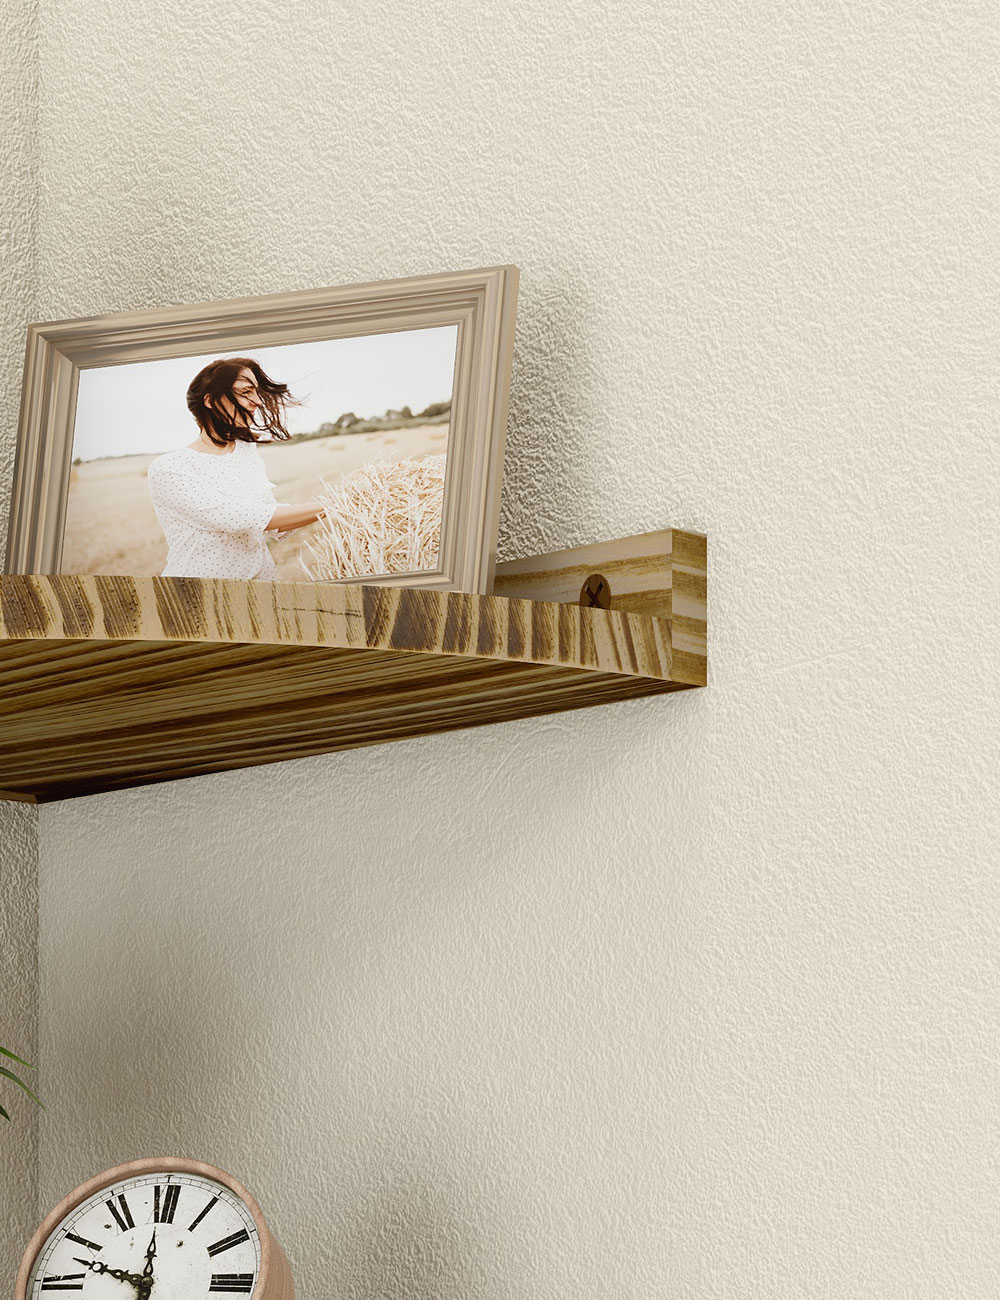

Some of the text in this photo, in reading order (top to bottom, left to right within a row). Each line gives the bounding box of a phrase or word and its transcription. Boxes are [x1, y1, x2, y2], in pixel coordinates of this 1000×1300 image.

[187, 1196, 220, 1233] I
[206, 1228, 251, 1258] II
[209, 1273, 254, 1294] III
